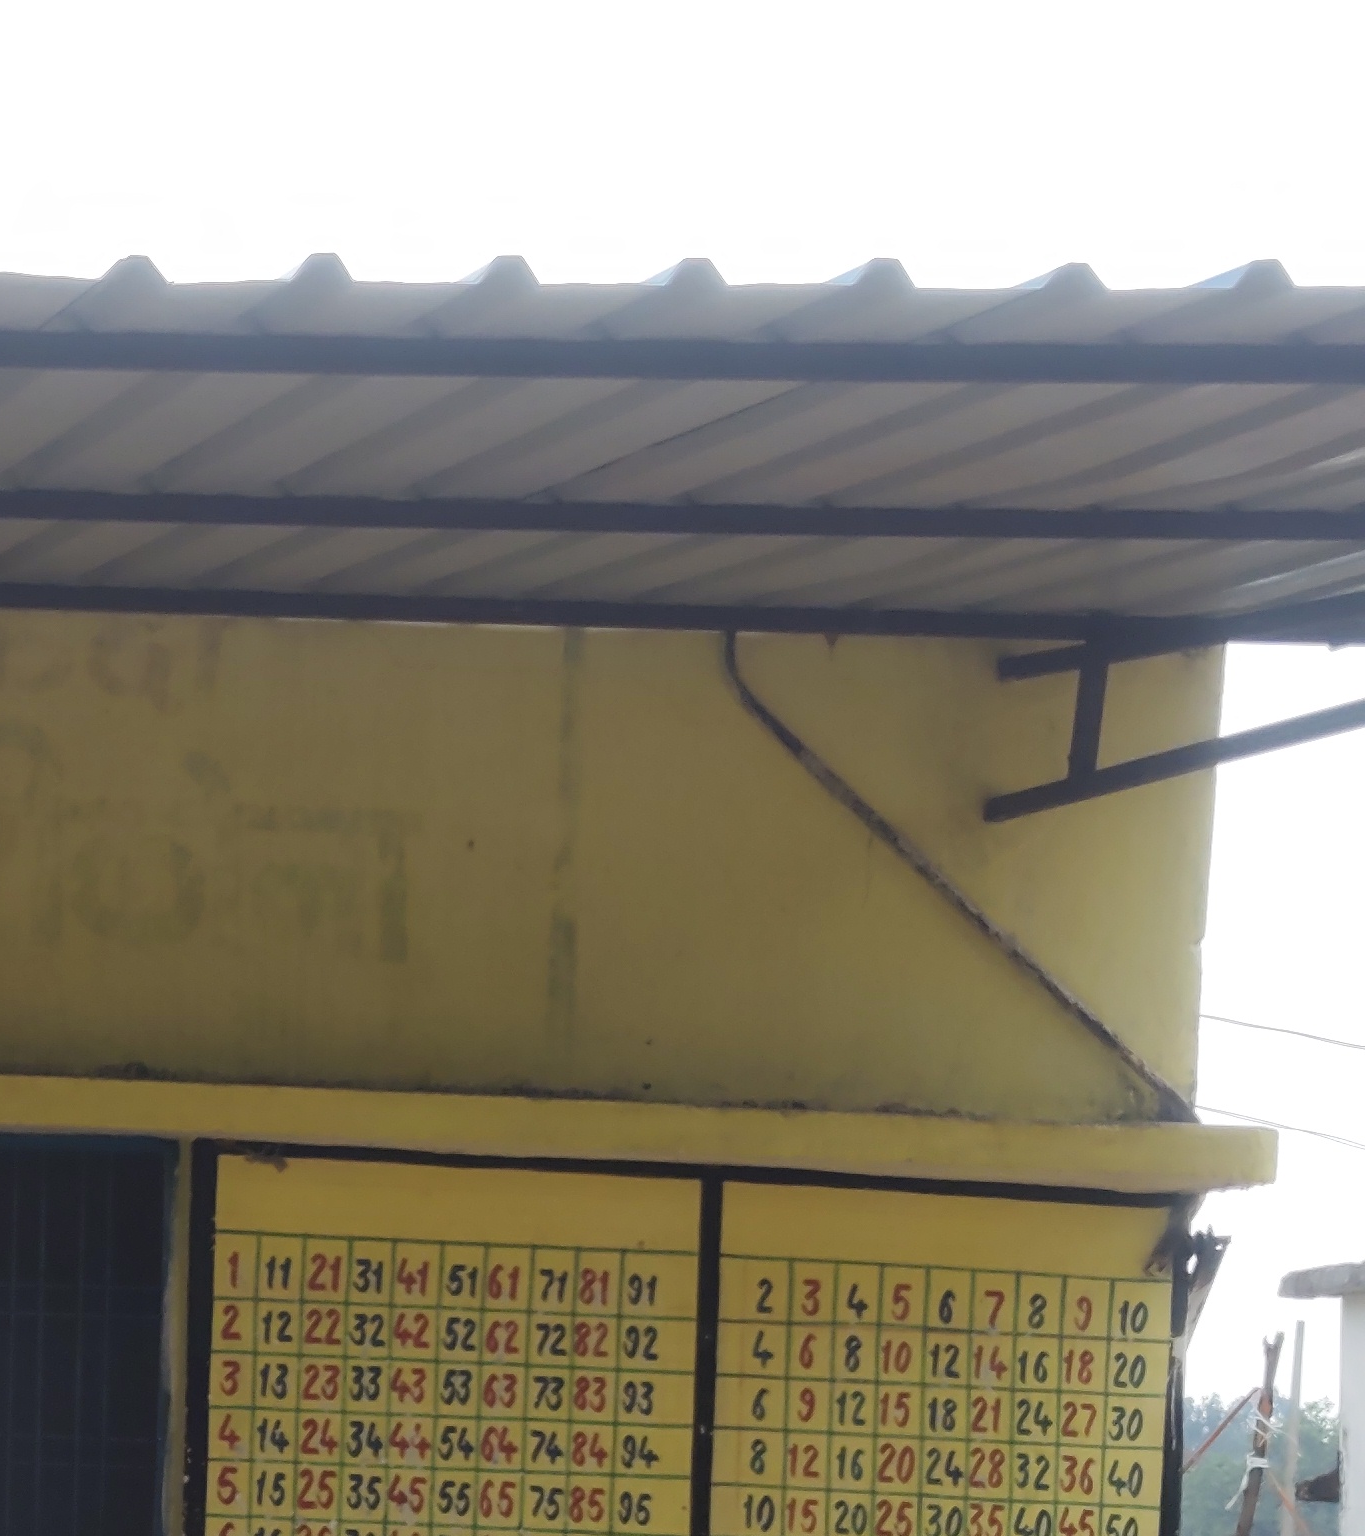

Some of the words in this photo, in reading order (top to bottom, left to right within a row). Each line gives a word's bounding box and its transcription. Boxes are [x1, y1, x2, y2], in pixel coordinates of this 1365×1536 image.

[227, 1250, 240, 1289] 1
[266, 1255, 292, 1290] 11
[306, 1252, 343, 1293] 21
[353, 1258, 384, 1294] 31
[396, 1257, 431, 1296] 41
[446, 1264, 479, 1298] 51
[487, 1263, 521, 1301] 61
[539, 1268, 569, 1303] 71
[579, 1267, 611, 1305] 81
[628, 1273, 658, 1306] 91
[756, 1278, 774, 1314] 2
[802, 1277, 823, 1318] 3
[846, 1283, 869, 1319] 4
[891, 1282, 913, 1322] 5
[938, 1289, 956, 1325] 6
[984, 1288, 1006, 1327] 7
[1028, 1293, 1047, 1330] 8
[1074, 1294, 1094, 1333] 9
[1118, 1300, 1149, 1336] 10
[221, 1305, 240, 1340] 2
[262, 1310, 293, 1344] 12
[304, 1307, 342, 1346] 22
[349, 1313, 386, 1348] 32
[393, 1311, 431, 1350] 42
[443, 1316, 477, 1352] 52
[484, 1319, 520, 1356] 62
[535, 1323, 568, 1357] 72
[573, 1320, 610, 1359] 82
[623, 1325, 659, 1361] 92
[752, 1330, 774, 1367] 4
[798, 1331, 818, 1371] 6
[844, 1334, 863, 1373] 8
[882, 1339, 912, 1374] 10
[930, 1343, 960, 1379] 12
[974, 1345, 1008, 1379] 14
[1017, 1350, 1050, 1384] 16
[1063, 1349, 1095, 1386] 18
[1113, 1351, 1147, 1389] 20
[219, 1359, 242, 1397] 3
[259, 1363, 289, 1400] 13
[301, 1364, 342, 1402] 23
[350, 1365, 383, 1402] 33
[390, 1366, 428, 1405] 43
[440, 1368, 473, 1406] 53
[482, 1372, 519, 1409] 63
[533, 1375, 566, 1412] 73
[573, 1375, 608, 1414] 83
[622, 1380, 655, 1416] 93
[751, 1387, 769, 1421] 6
[796, 1386, 817, 1424] 9
[835, 1390, 866, 1426] 12
[880, 1390, 911, 1428] 15
[927, 1397, 958, 1432] 18
[971, 1395, 1002, 1434] 21
[1015, 1398, 1053, 1436] 24
[1061, 1400, 1098, 1439] 27
[1108, 1405, 1144, 1442] 30
[215, 1464, 239, 1507] 5
[256, 1470, 286, 1507] 15
[296, 1467, 336, 1511] 25
[346, 1473, 383, 1511] 35
[386, 1474, 429, 1515] 45
[438, 1480, 471, 1517] 55
[477, 1480, 517, 1520] 65
[529, 1485, 566, 1521] 75
[568, 1485, 606, 1524] 85
[618, 1491, 652, 1526] 95
[750, 1438, 767, 1475] 8
[788, 1443, 820, 1480] 12
[836, 1446, 865, 1482] 16
[877, 1441, 916, 1484] 20
[925, 1447, 965, 1487] 24
[968, 1446, 1006, 1490] 28
[1016, 1452, 1050, 1491] 32
[1060, 1454, 1095, 1496] 36
[1107, 1459, 1144, 1499] 40
